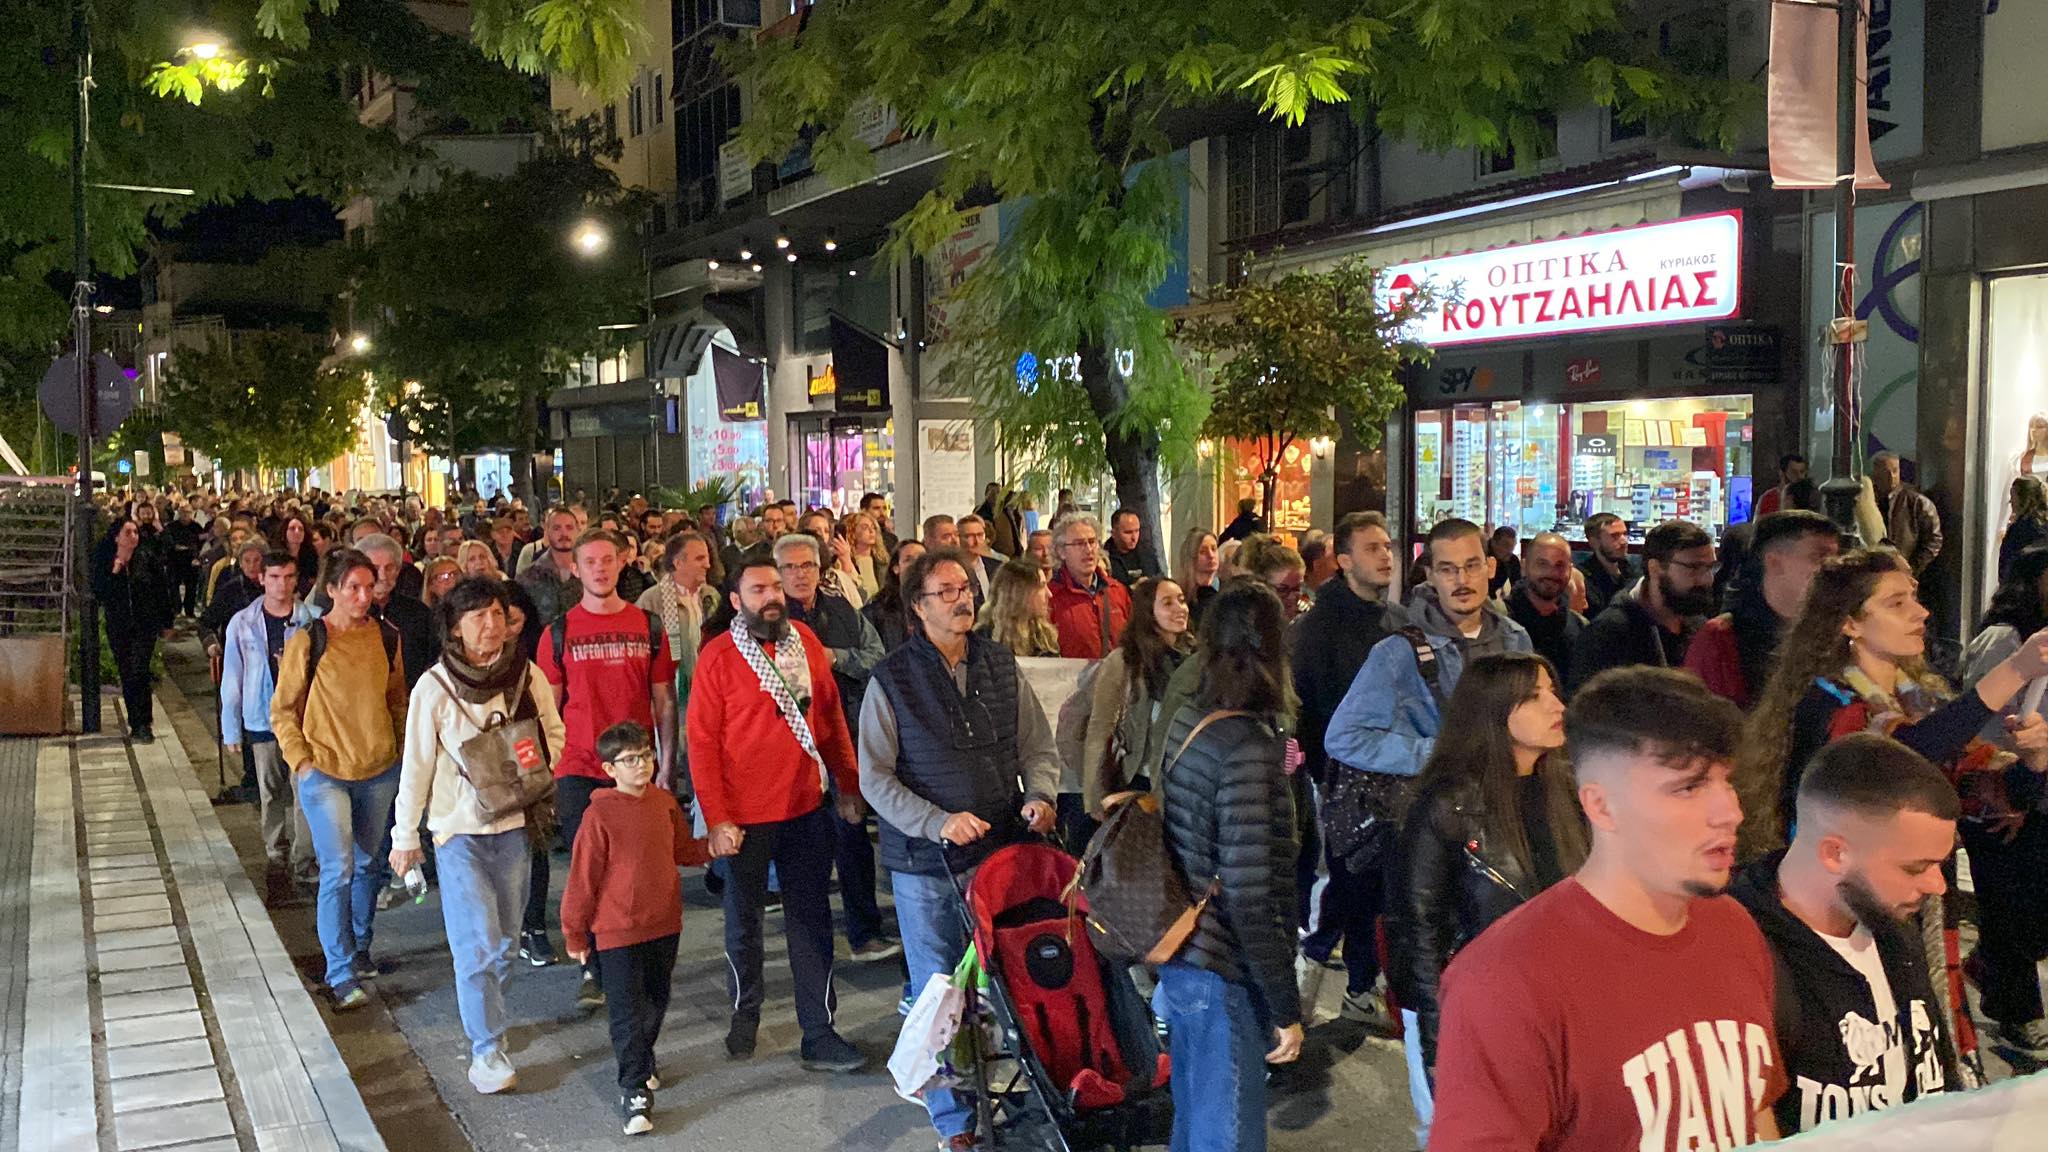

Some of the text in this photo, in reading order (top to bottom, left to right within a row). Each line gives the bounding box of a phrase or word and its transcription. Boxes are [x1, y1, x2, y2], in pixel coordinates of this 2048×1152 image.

[1488, 249, 1629, 288] ΟΠΤΙΚΑ
[1660, 253, 1717, 270] ΚΥΡΙΑΚΟΣ
[1442, 270, 1718, 332] ΚΟΥΤΖΑΗΛΙΑΣ
[572, 641, 625, 662] EXPEDITION
